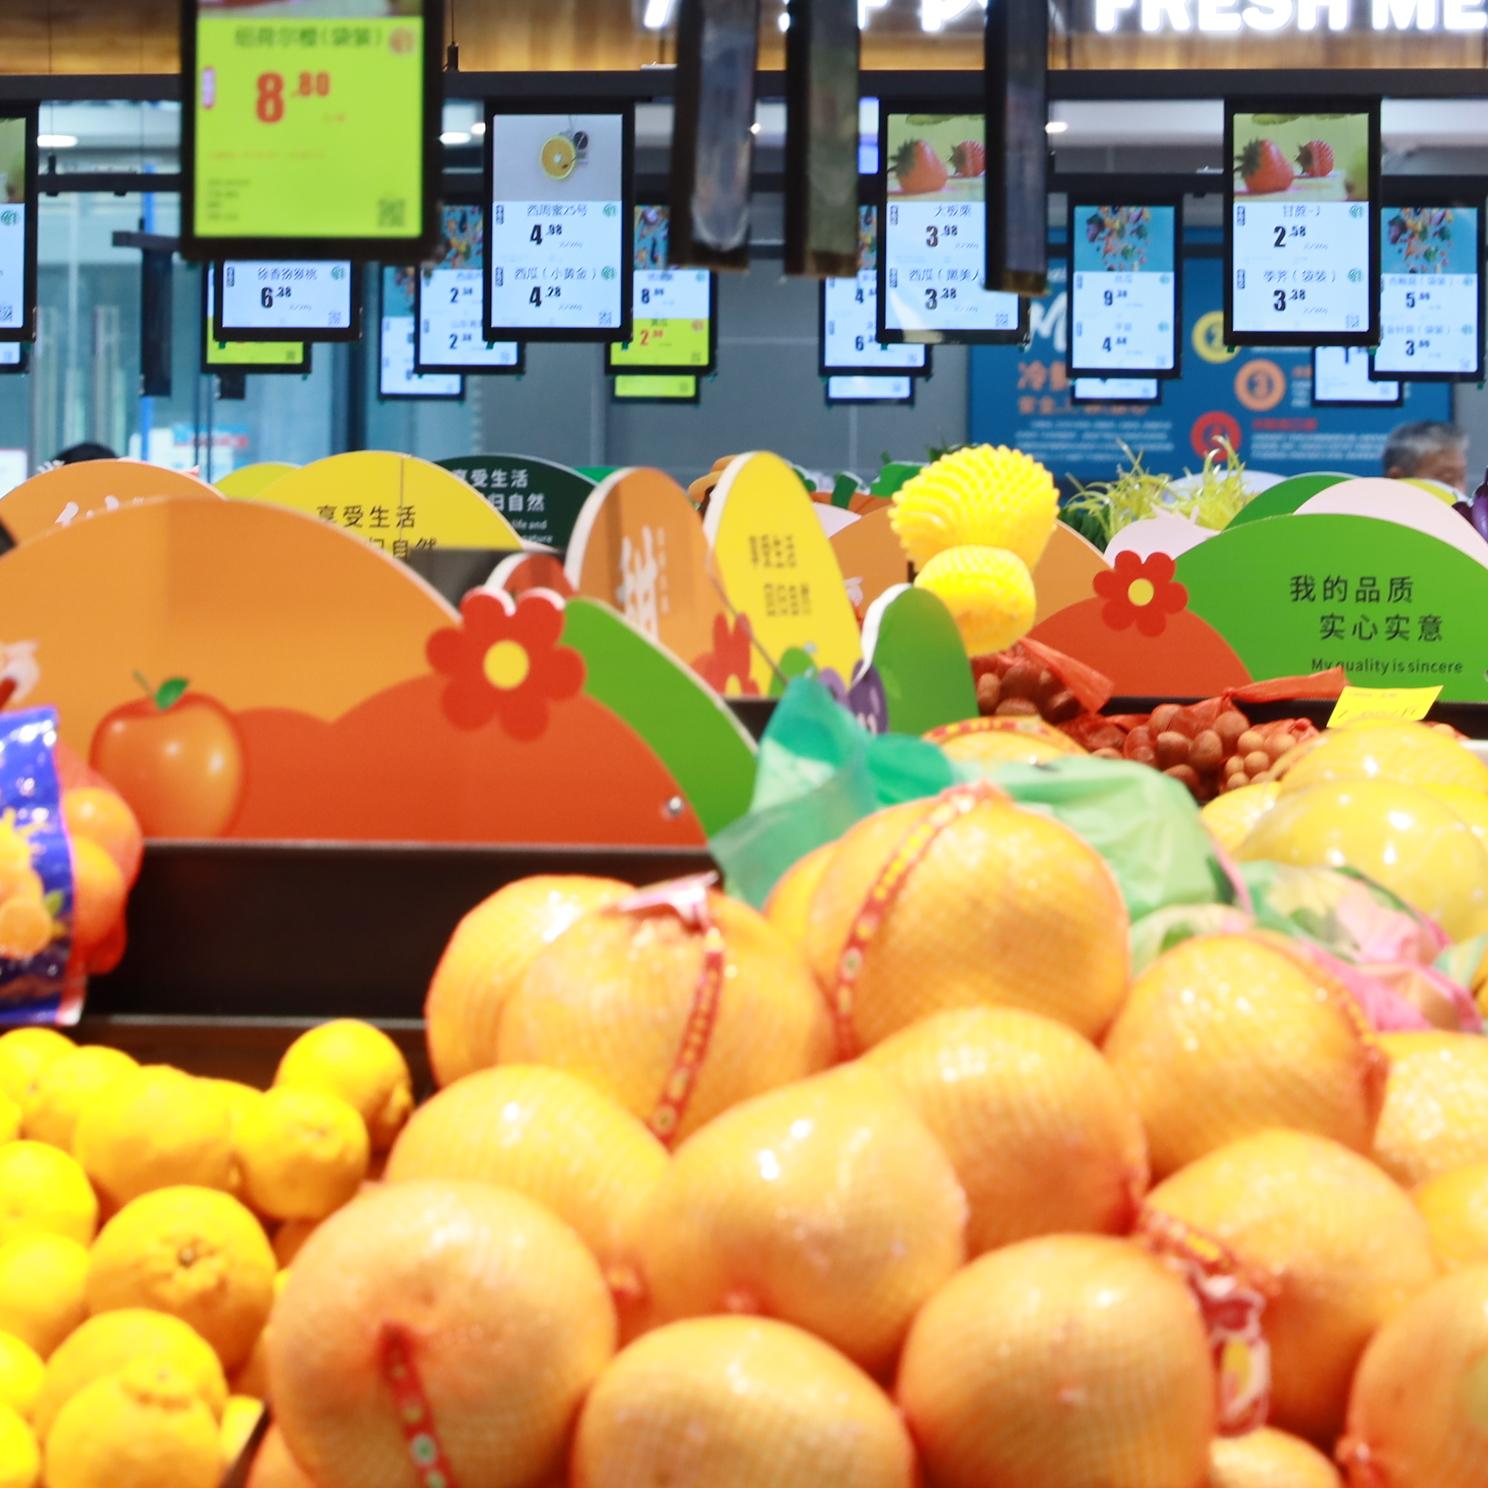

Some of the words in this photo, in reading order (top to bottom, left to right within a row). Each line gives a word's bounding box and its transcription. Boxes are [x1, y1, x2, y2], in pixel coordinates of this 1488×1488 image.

[255, 70, 330, 125] 8.80
[484, 492, 546, 513] 归自然
[1289, 574, 1414, 604] 我的品质
[1320, 612, 1443, 642] 实心实意
[1392, 659, 1406, 673] is
[1409, 659, 1464, 673] sincere
